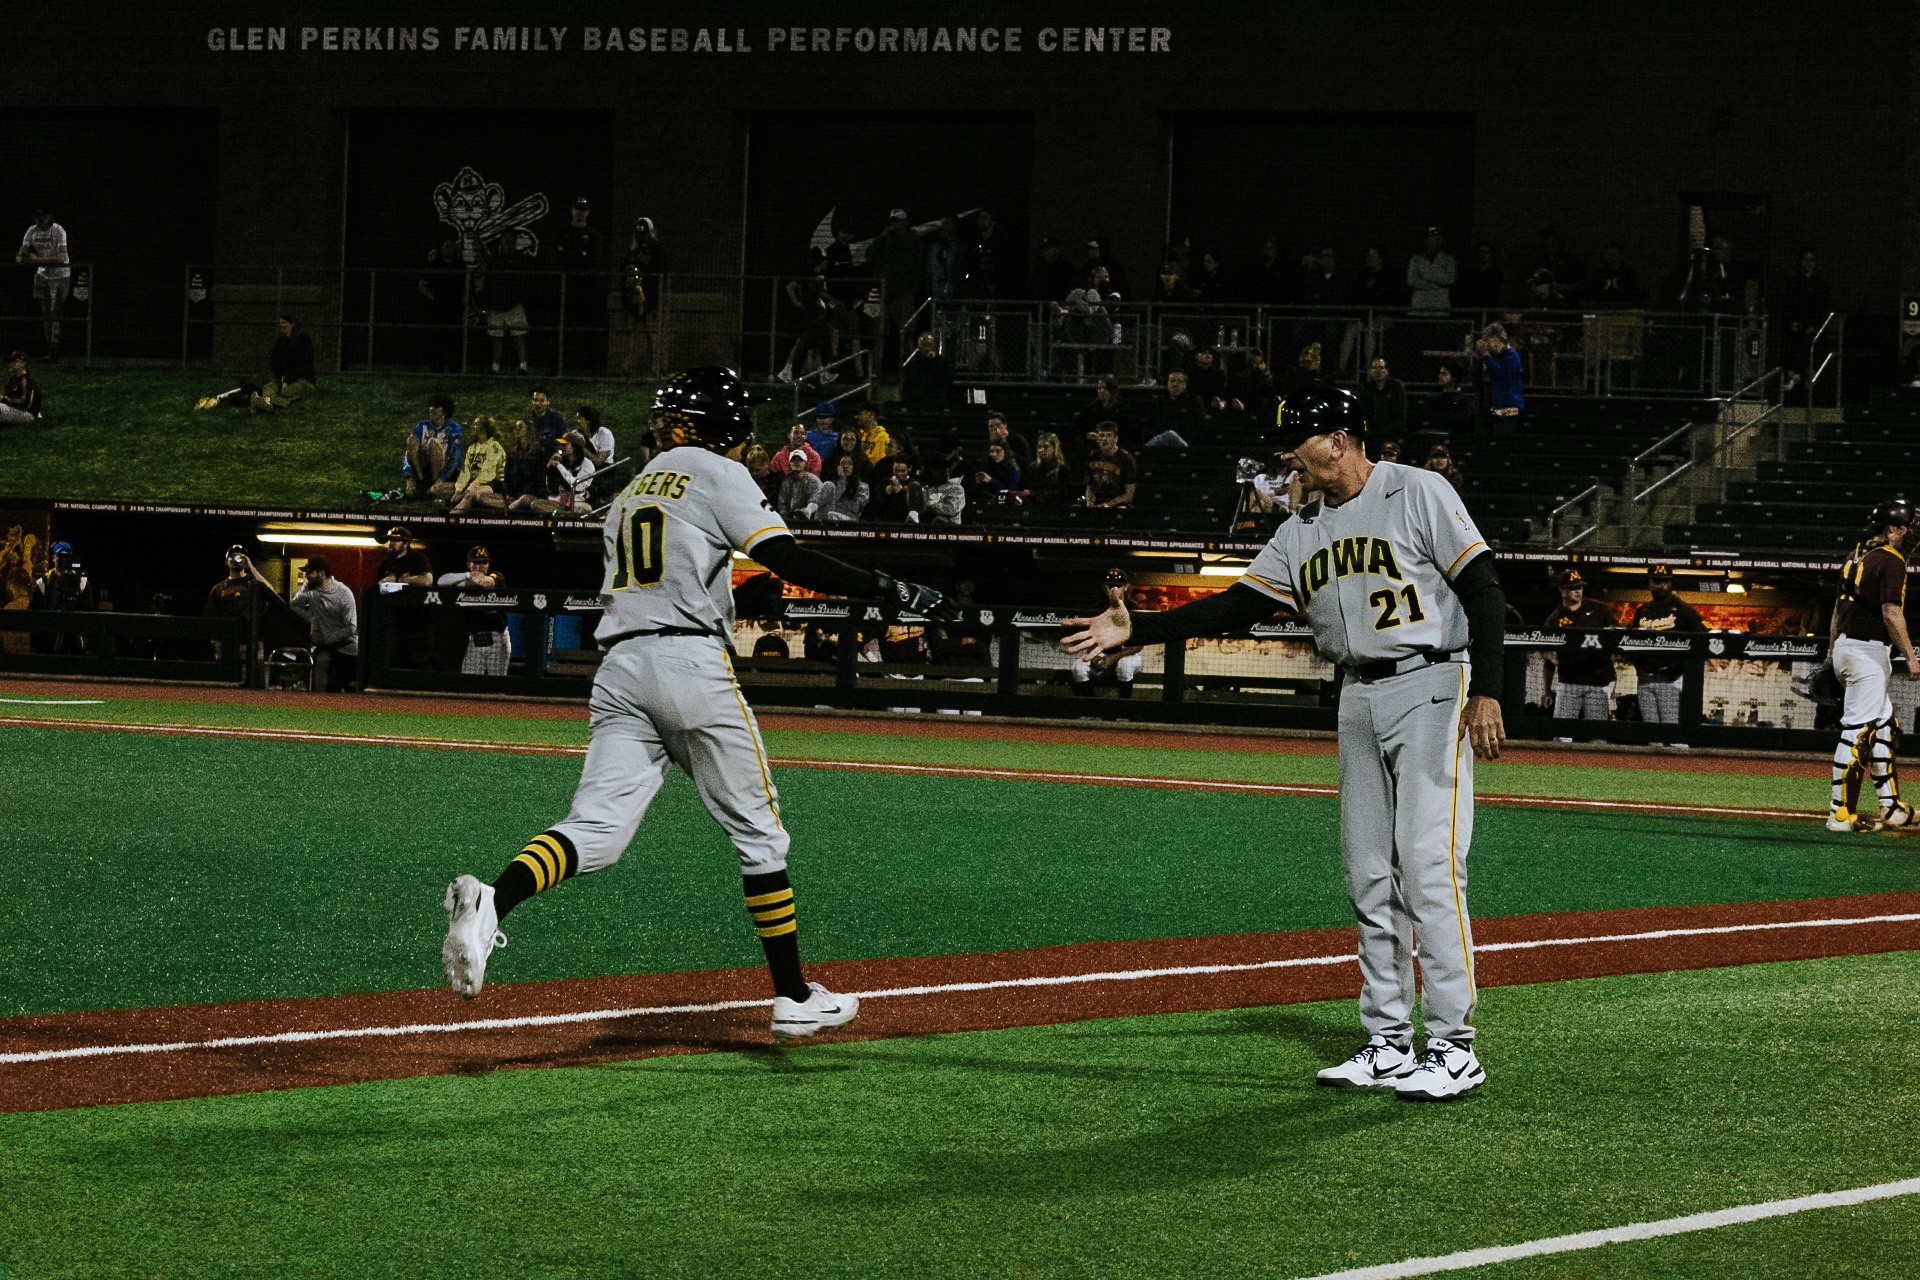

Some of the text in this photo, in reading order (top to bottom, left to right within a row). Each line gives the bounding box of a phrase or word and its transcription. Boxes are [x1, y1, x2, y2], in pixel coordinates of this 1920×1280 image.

[207, 27, 1172, 52] GLEN PERKINS FAMILY BASEBALL PERFORMANCE CENTER
[1909, 301, 1919, 316] 9
[635, 471, 691, 501] GERS
[480, 518, 510, 526] TOURNAMENT
[611, 503, 666, 591] 10
[1300, 536, 1403, 609] IOWA
[456, 592, 519, 603] Minnesota Baseball
[564, 595, 595, 606] Minnesota
[785, 602, 850, 614] Minnesota Baseball
[1369, 583, 1425, 631] 21
[1012, 612, 1044, 623] Minnesota
[1250, 622, 1283, 632] Minnesota
[1530, 630, 1567, 642] Baseball
[1619, 635, 1691, 648] Minnesota Baseball
[1745, 640, 1818, 652] Minnesota Baseball
